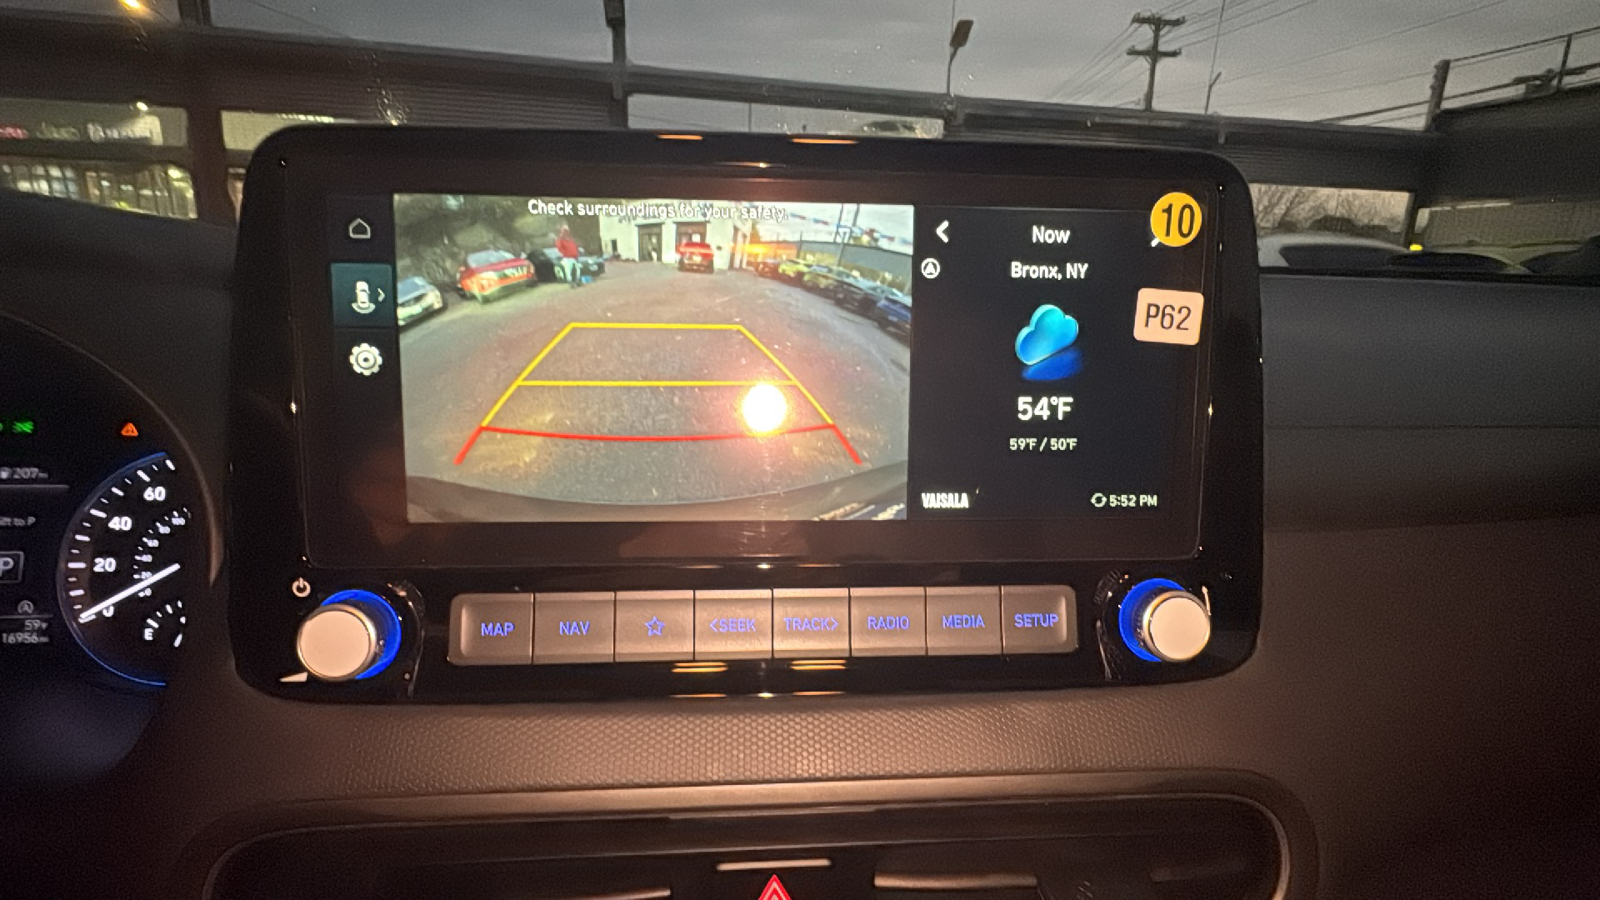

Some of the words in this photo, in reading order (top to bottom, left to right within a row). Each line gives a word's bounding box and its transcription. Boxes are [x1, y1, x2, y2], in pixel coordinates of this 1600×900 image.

[528, 199, 574, 215] Check
[577, 202, 676, 219] surroundings
[679, 202, 702, 218] for
[704, 205, 737, 221] your
[740, 205, 790, 222] safety.
[1161, 203, 1196, 239] 10
[1032, 225, 1071, 244] Now
[1010, 261, 1063, 280] Bronx,
[1066, 262, 1089, 279] NY
[1144, 302, 1192, 331] P62
[1017, 396, 1073, 421] 54°F
[143, 486, 166, 501] 60
[921, 493, 969, 509] VAISALA
[1109, 494, 1137, 508] 5:52
[1139, 494, 1158, 508] PM
[108, 516, 132, 531] 40
[93, 557, 117, 573] 20
[559, 620, 591, 636] NAV
[867, 615, 911, 630] RADIO
[942, 614, 985, 629] MEDIA
[1014, 613, 1059, 628] SETUP
[144, 627, 154, 641] E
[481, 621, 516, 637] MAP
